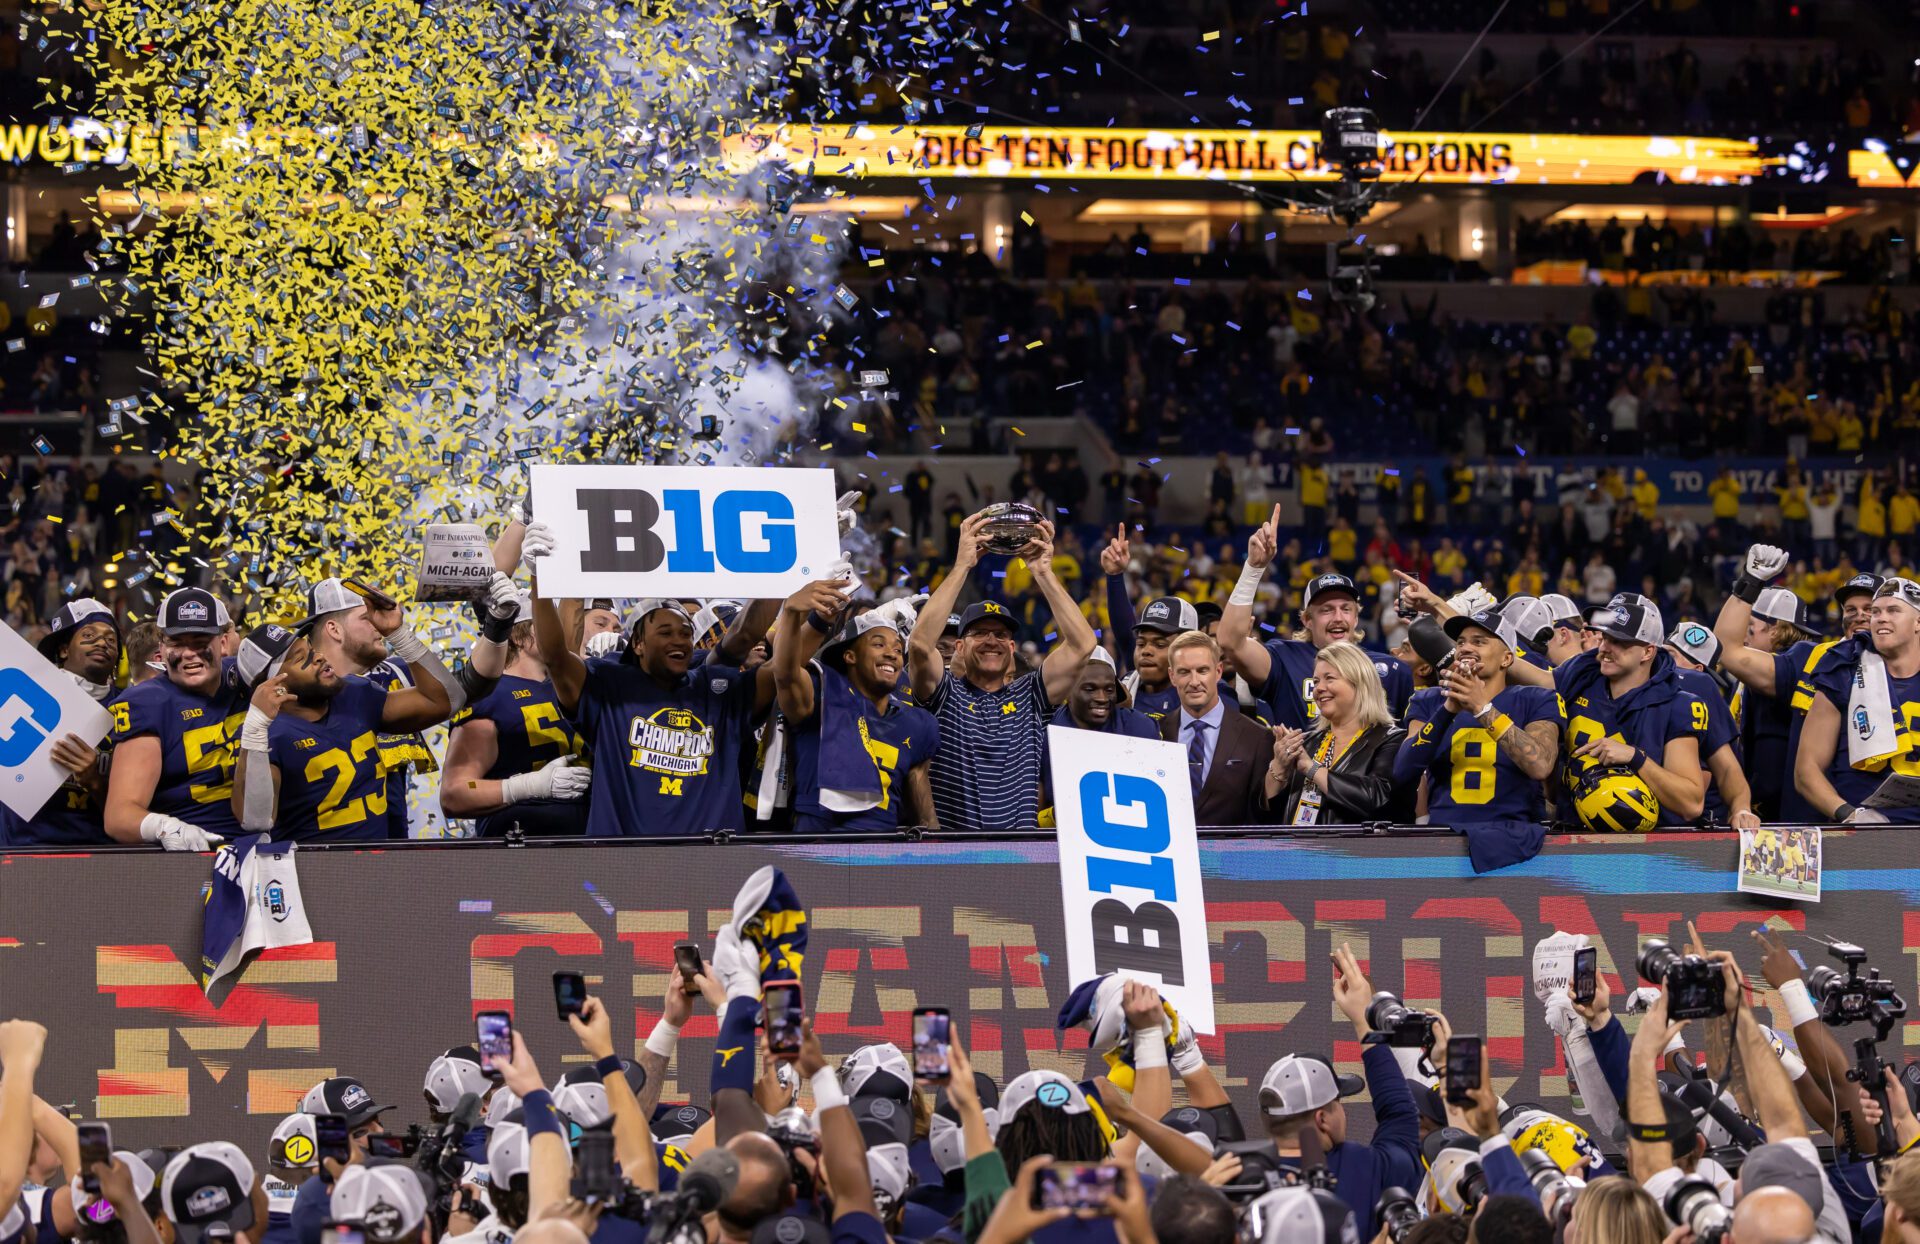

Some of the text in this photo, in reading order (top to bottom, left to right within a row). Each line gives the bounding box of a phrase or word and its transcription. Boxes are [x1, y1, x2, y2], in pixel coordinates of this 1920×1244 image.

[997, 137, 1070, 168] TEN
[1085, 138, 1276, 171] FOOTBALL
[984, 603, 1001, 614] M
[1002, 701, 1017, 715] M
[1691, 702, 1709, 731] 91
[647, 752, 698, 771] MICHIGAN
[1450, 728, 1497, 805] 8
[304, 730, 389, 830] 23
[659, 776, 683, 796] M
